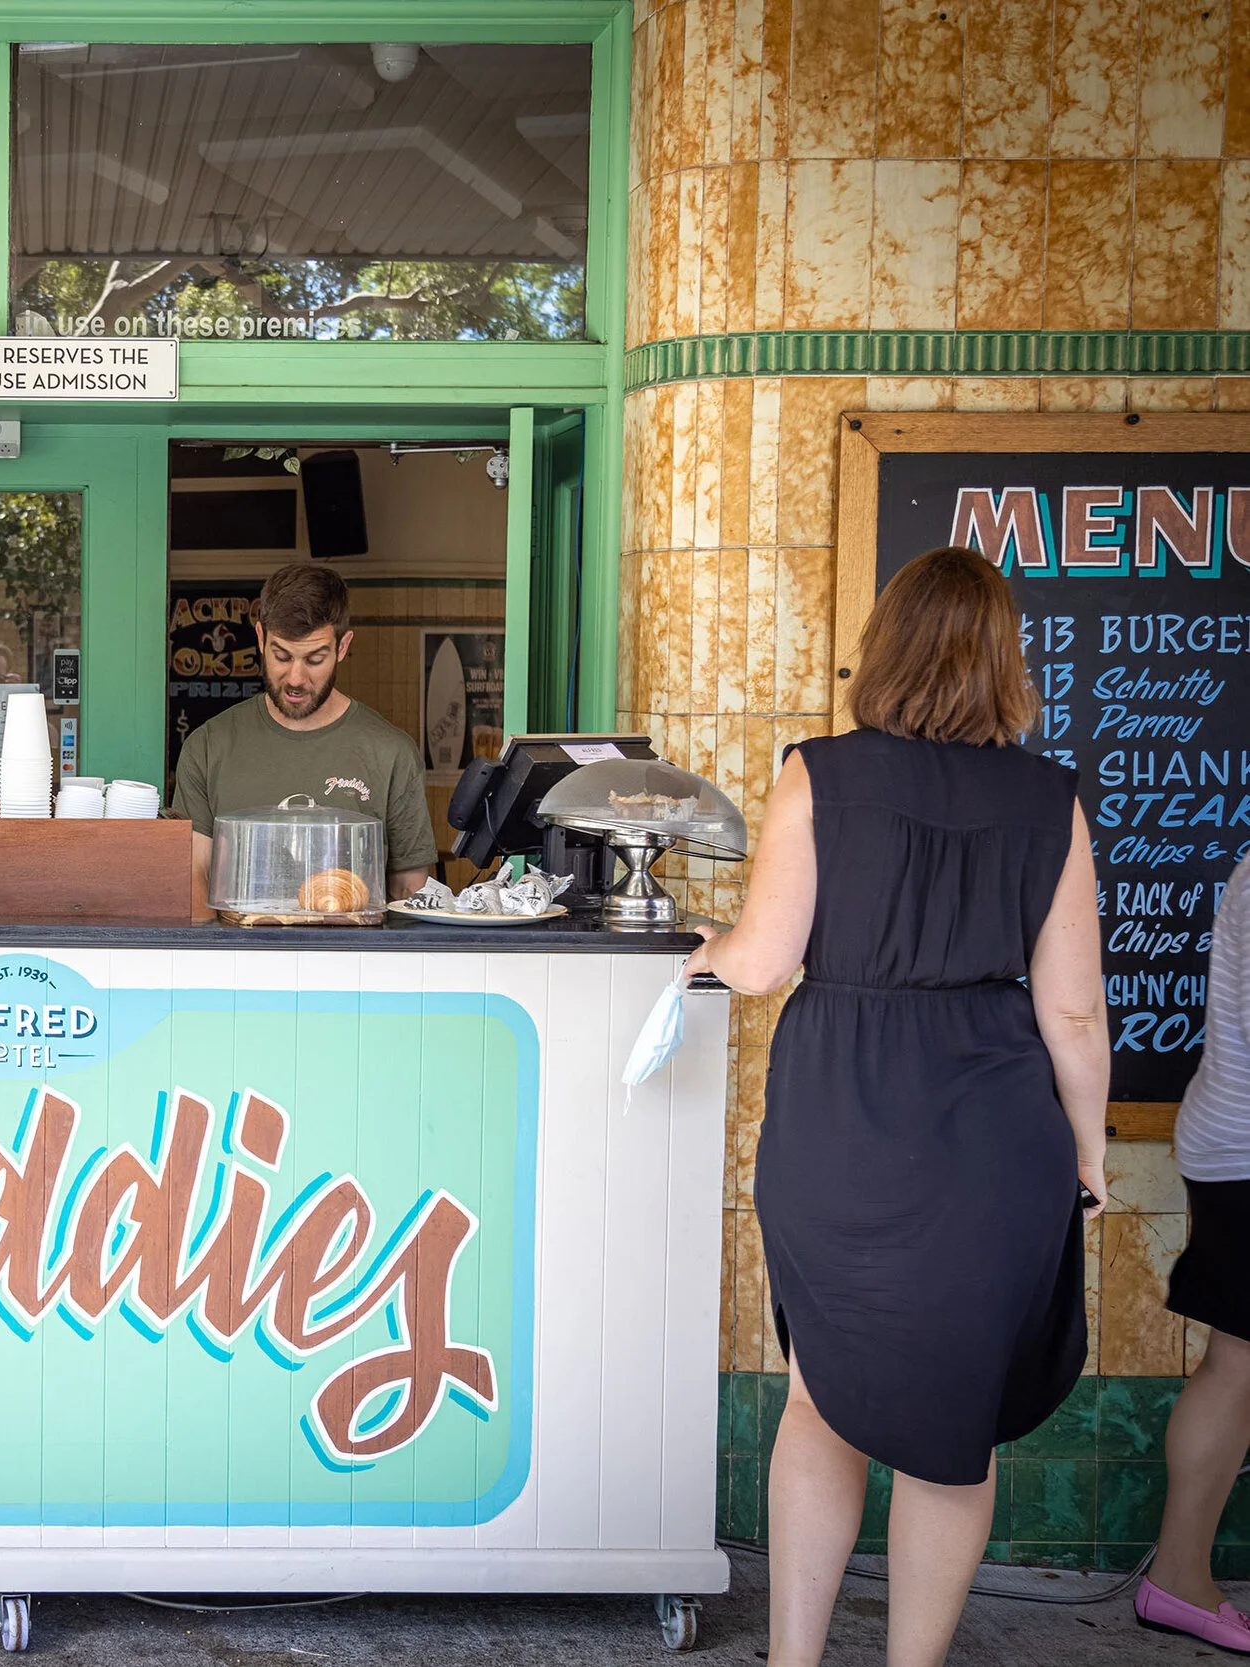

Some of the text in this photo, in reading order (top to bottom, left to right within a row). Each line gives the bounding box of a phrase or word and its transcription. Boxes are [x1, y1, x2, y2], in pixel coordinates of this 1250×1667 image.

[58, 315, 106, 337] use
[115, 315, 148, 337] on
[157, 310, 233, 338] these
[240, 311, 363, 340] premises
[4, 347, 104, 365] RESERVES
[109, 348, 149, 365] THE
[32, 373, 147, 391] ADMISSION
[1098, 613, 1250, 656] BURGE
[59, 666, 75, 674] with
[60, 659, 75, 667] pay
[1092, 666, 1225, 706] Schnitty
[1092, 705, 1203, 743] Parmy
[1109, 836, 1195, 869] Chips
[1203, 841, 1227, 859] &
[1116, 882, 1175, 916] RACK
[1178, 882, 1204, 917] of
[1108, 921, 1191, 961] Chips
[18, 966, 49, 984] 1939
